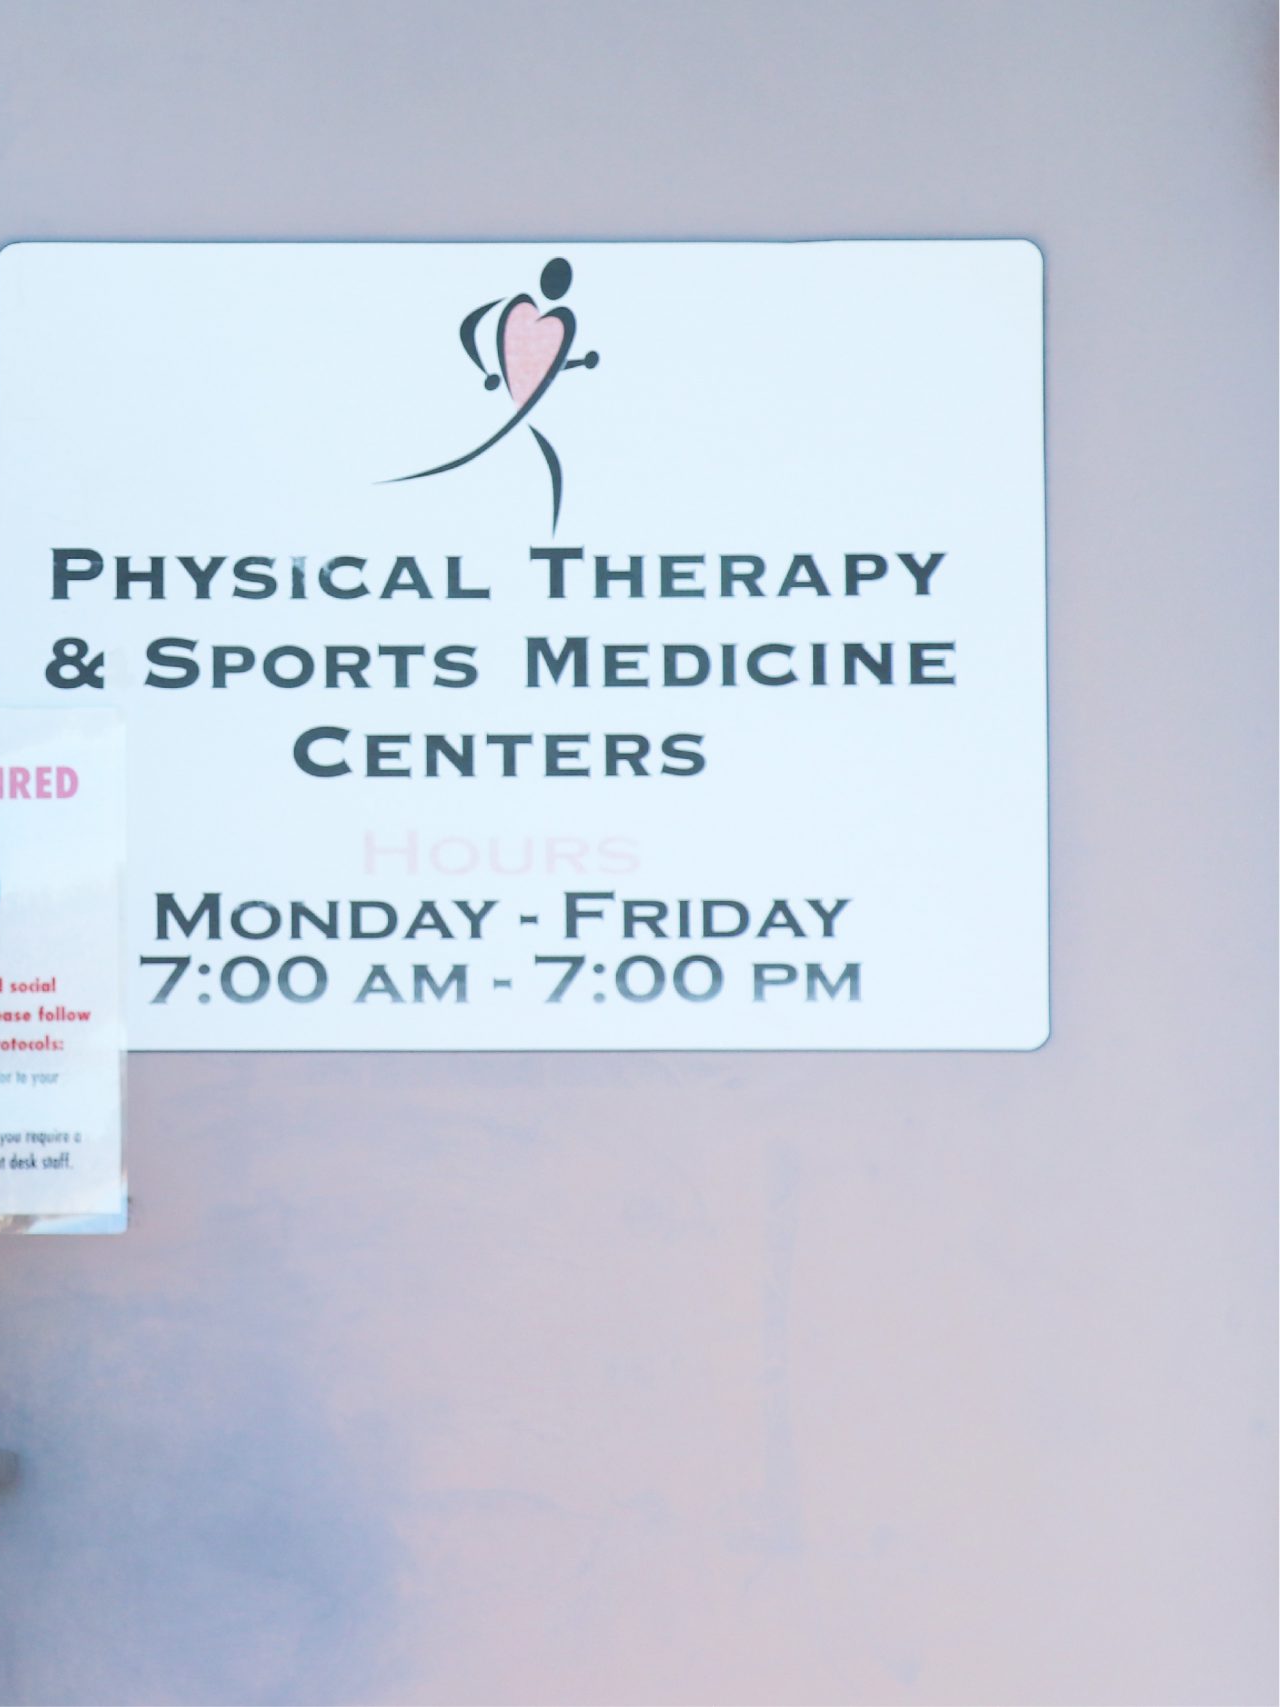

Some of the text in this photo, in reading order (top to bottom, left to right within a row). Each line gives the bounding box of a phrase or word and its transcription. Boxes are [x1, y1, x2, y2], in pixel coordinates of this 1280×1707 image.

[50, 545, 949, 600] PHYSICAL THERAPY
[45, 635, 957, 689] & SPORTS MEDICINE
[293, 726, 706, 778] CENTERS
[363, 830, 641, 876] HOURS
[154, 892, 501, 940] MONDAY
[564, 890, 853, 939] FRIDAY
[10, 976, 56, 993] social
[139, 955, 328, 1004] 7:00
[353, 963, 469, 1003] AM
[535, 954, 725, 1003] 7:00
[752, 962, 862, 1003] PM
[39, 1006, 91, 1022] follow
[15, 1070, 27, 1083] to
[32, 1072, 59, 1087] your
[0, 1132, 21, 1147] you
[25, 1129, 69, 1147] require
[10, 1152, 37, 1169] desk
[42, 1152, 74, 1169] staff.
